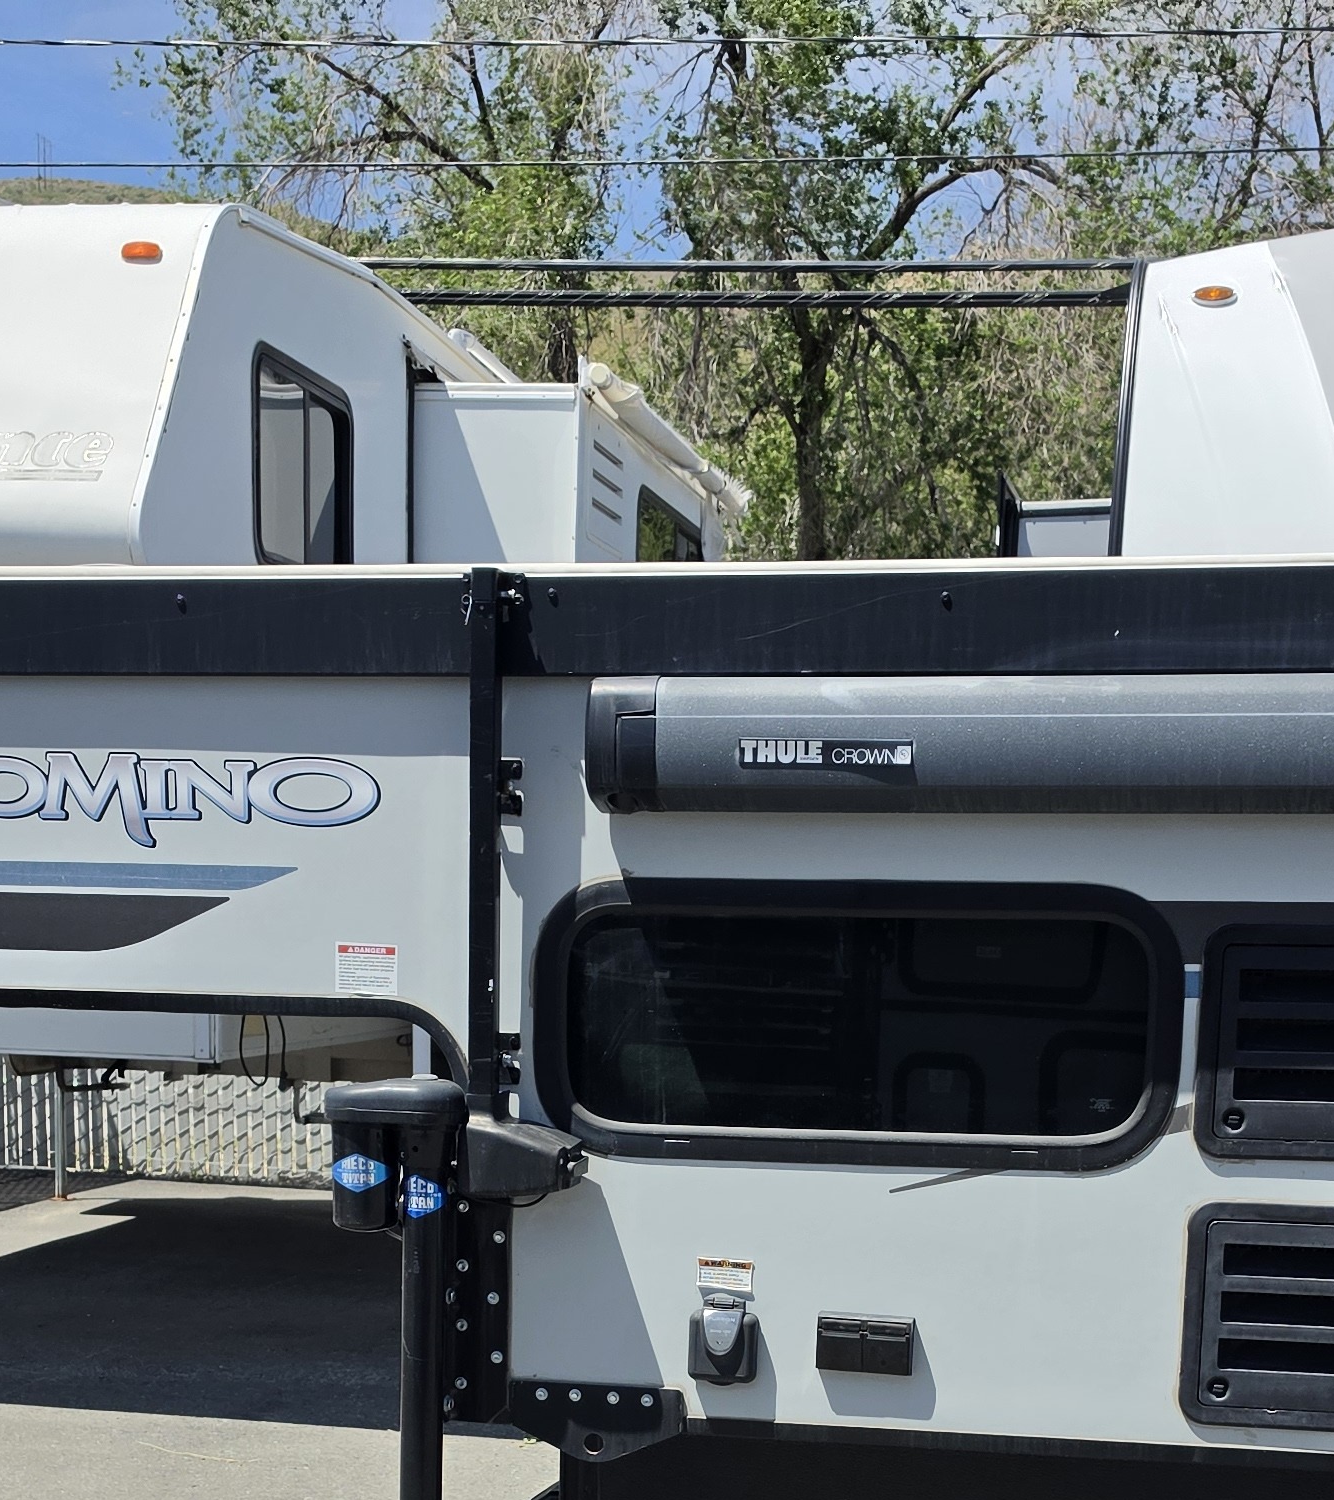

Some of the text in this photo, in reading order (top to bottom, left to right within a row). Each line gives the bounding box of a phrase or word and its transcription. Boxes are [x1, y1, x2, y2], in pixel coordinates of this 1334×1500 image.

[740, 740, 898, 765] THULE CROWN
[354, 946, 387, 954] DANGER
